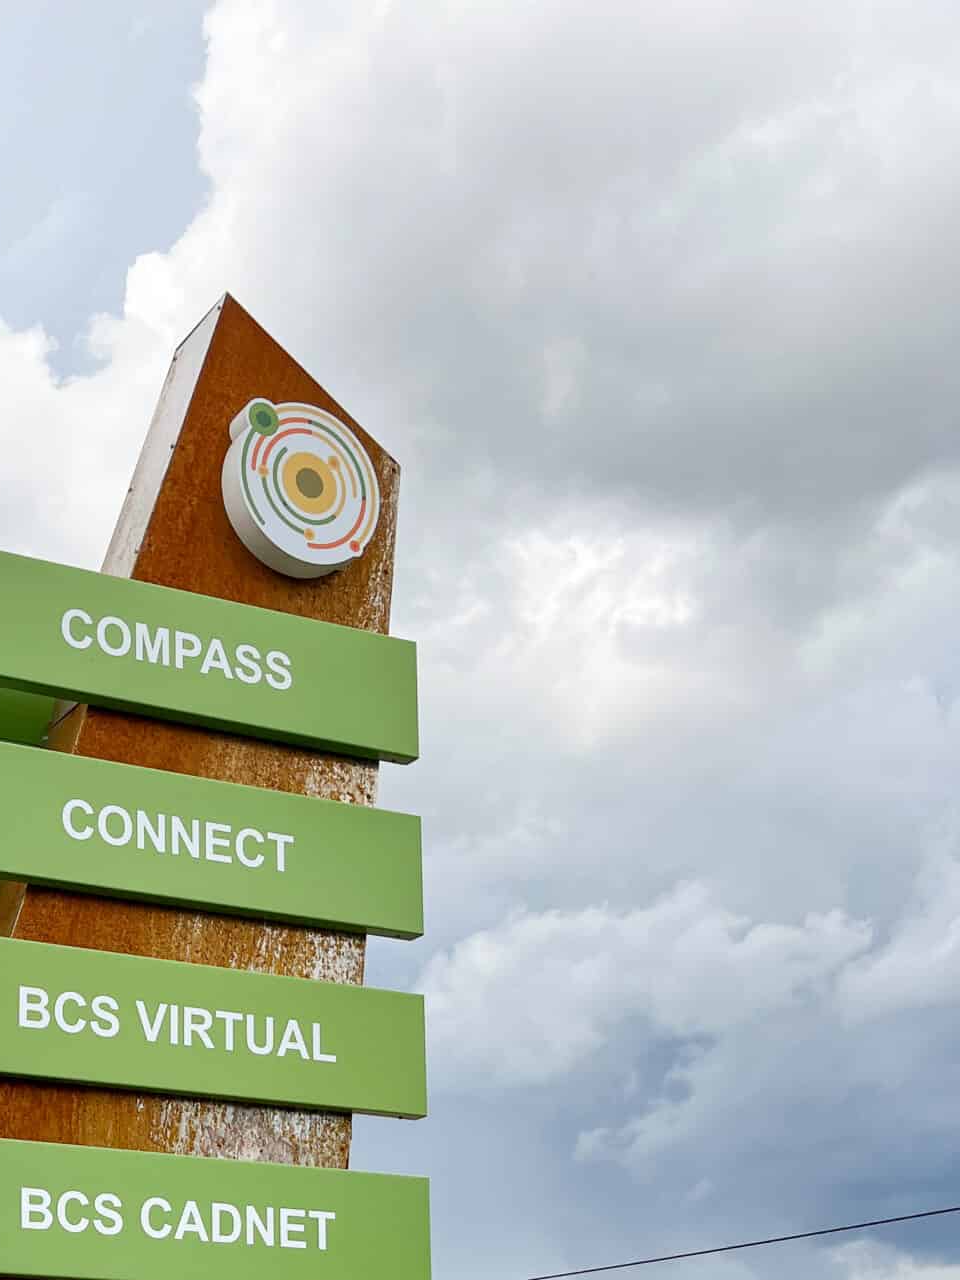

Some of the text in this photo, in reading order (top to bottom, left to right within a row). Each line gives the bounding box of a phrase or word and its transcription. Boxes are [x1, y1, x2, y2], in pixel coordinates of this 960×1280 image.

[61, 608, 294, 691] COMPASS
[61, 798, 295, 873] CONNECT
[18, 984, 337, 1063] BCS VIRTUAL
[20, 1186, 337, 1251] BCS CADNET
